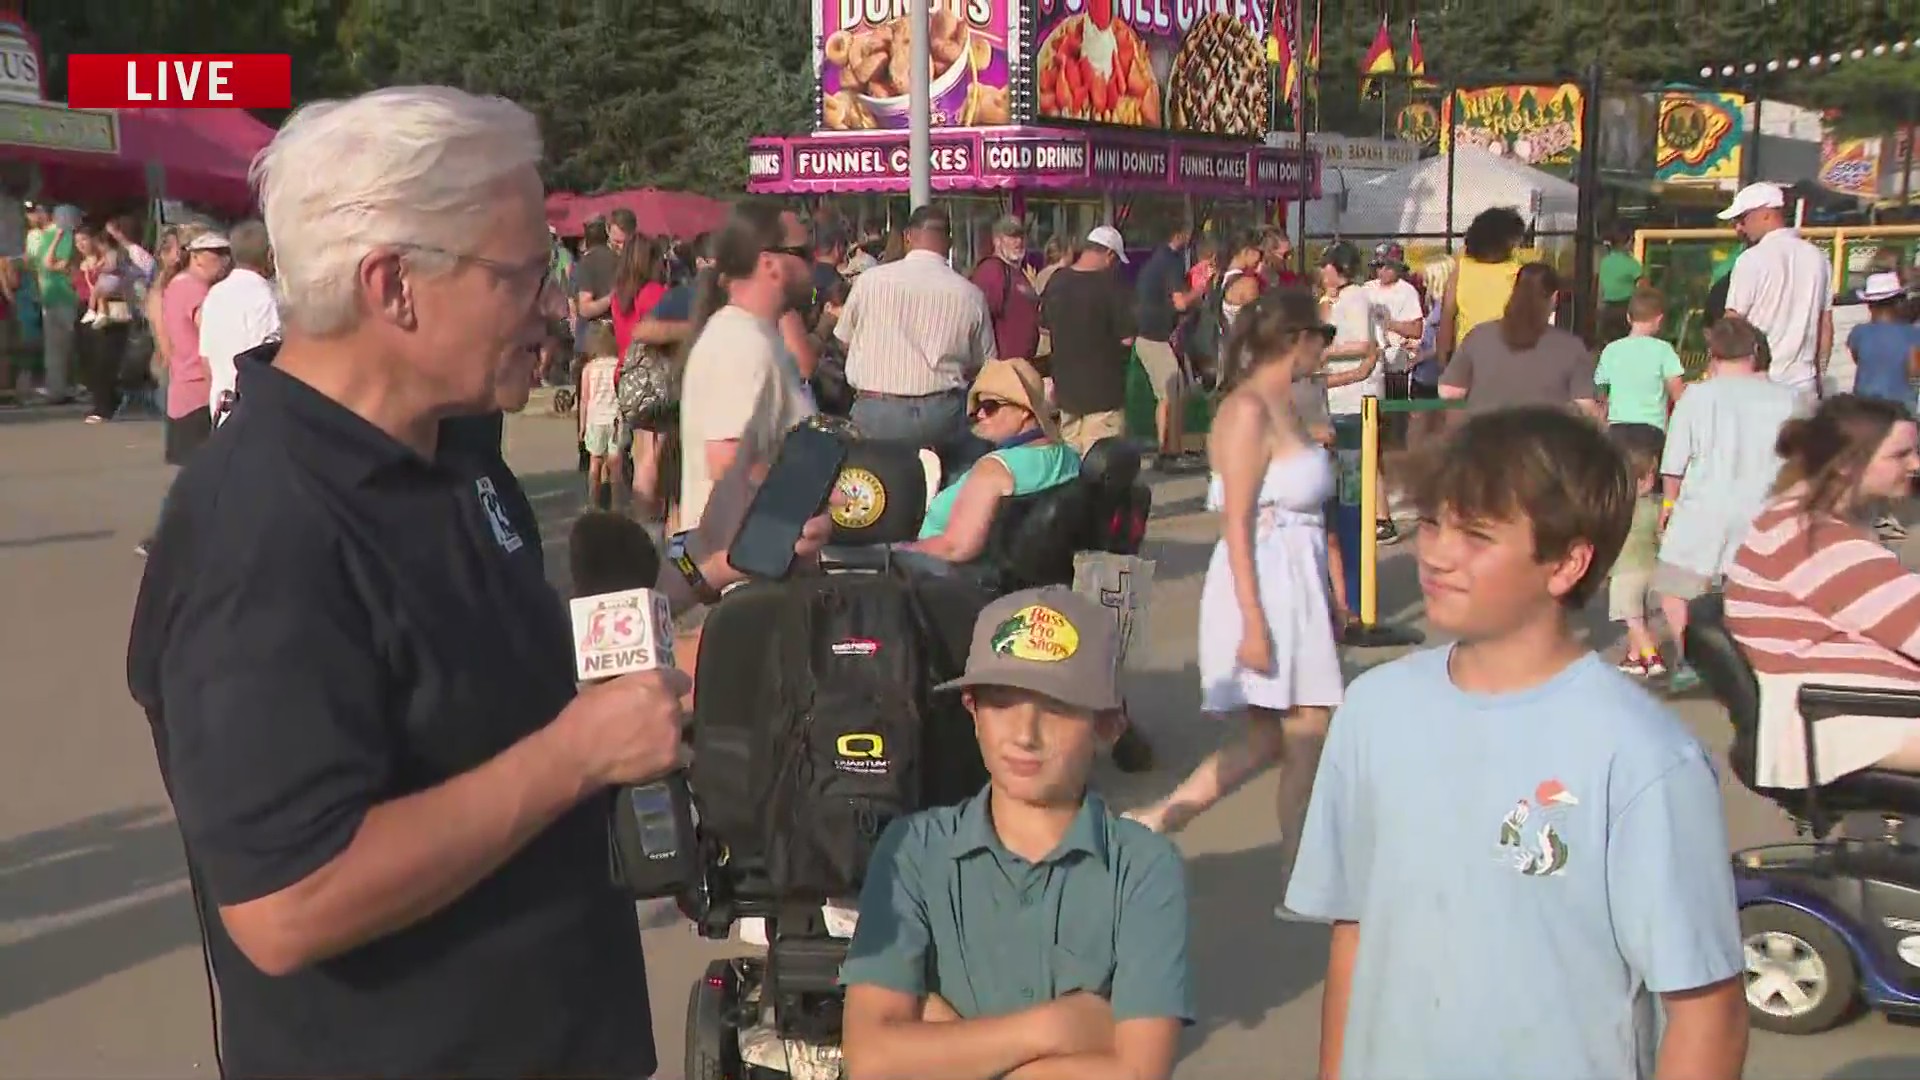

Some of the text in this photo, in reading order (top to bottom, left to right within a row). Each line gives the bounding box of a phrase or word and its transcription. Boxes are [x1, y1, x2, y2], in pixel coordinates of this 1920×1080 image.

[1464, 87, 1506, 120] NUT
[799, 148, 969, 175] FUNNEL CKES
[989, 146, 1084, 169] COLD DRINKS
[1094, 148, 1166, 174] MINI DONUTS
[1179, 155, 1245, 179] FUNNEL CAKES
[1256, 161, 1278, 179] MINI
[1031, 606, 1066, 627] Bass
[1027, 622, 1055, 639] Pro
[1025, 638, 1070, 657] Shops
[584, 648, 649, 673] NEWS
[836, 733, 884, 759] Q
